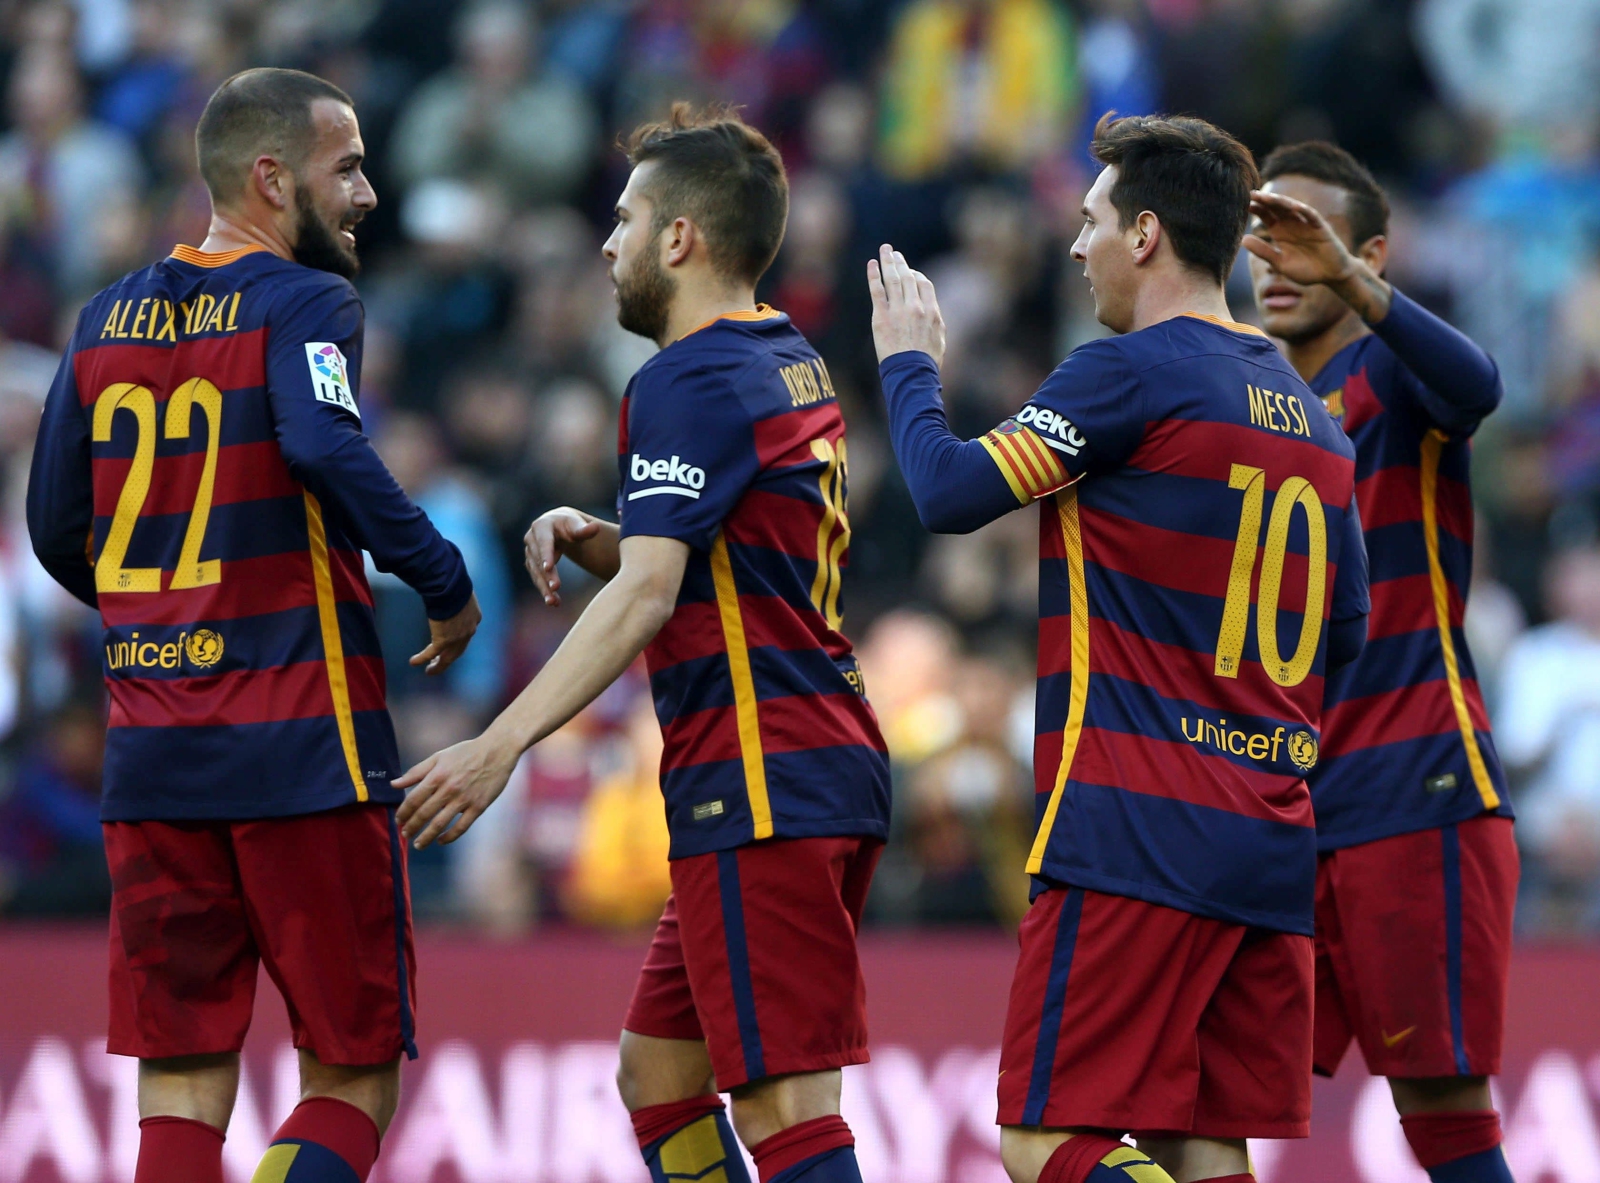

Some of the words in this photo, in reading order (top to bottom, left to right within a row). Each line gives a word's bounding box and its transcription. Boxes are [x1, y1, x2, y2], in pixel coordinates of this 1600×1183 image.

[100, 297, 177, 342] ALEIX
[779, 360, 822, 407] JORDI
[1016, 404, 1087, 447] beko
[1246, 383, 1311, 438] MESSI
[92, 377, 223, 593] 22
[631, 453, 706, 490] beko
[1213, 463, 1328, 687] 10
[106, 631, 187, 670] unicef
[1181, 717, 1286, 762] unicef
